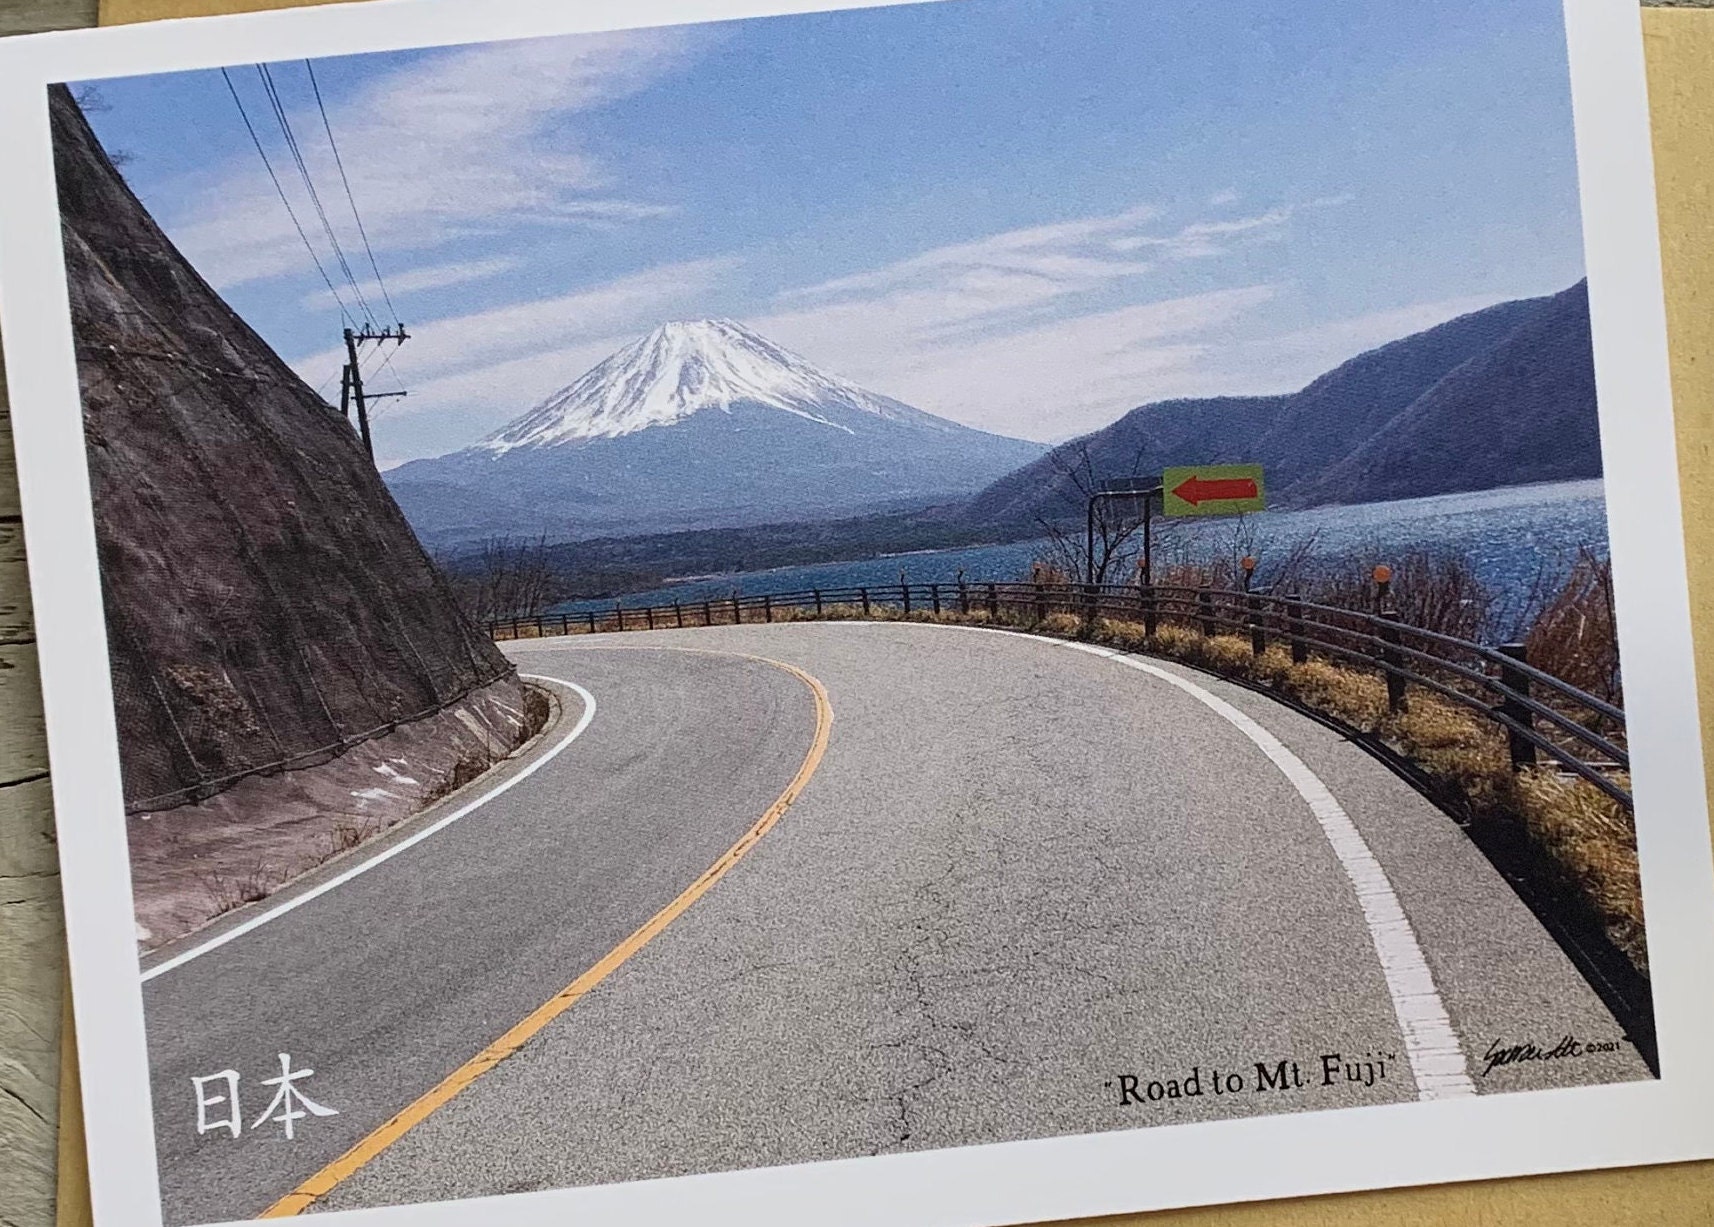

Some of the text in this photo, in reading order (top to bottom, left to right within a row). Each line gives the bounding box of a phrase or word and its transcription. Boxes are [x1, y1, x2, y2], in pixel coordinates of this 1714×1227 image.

[190, 1052, 340, 1140] 日本
[1212, 1070, 1244, 1095] to
[1254, 1060, 1311, 1092] Mt.
